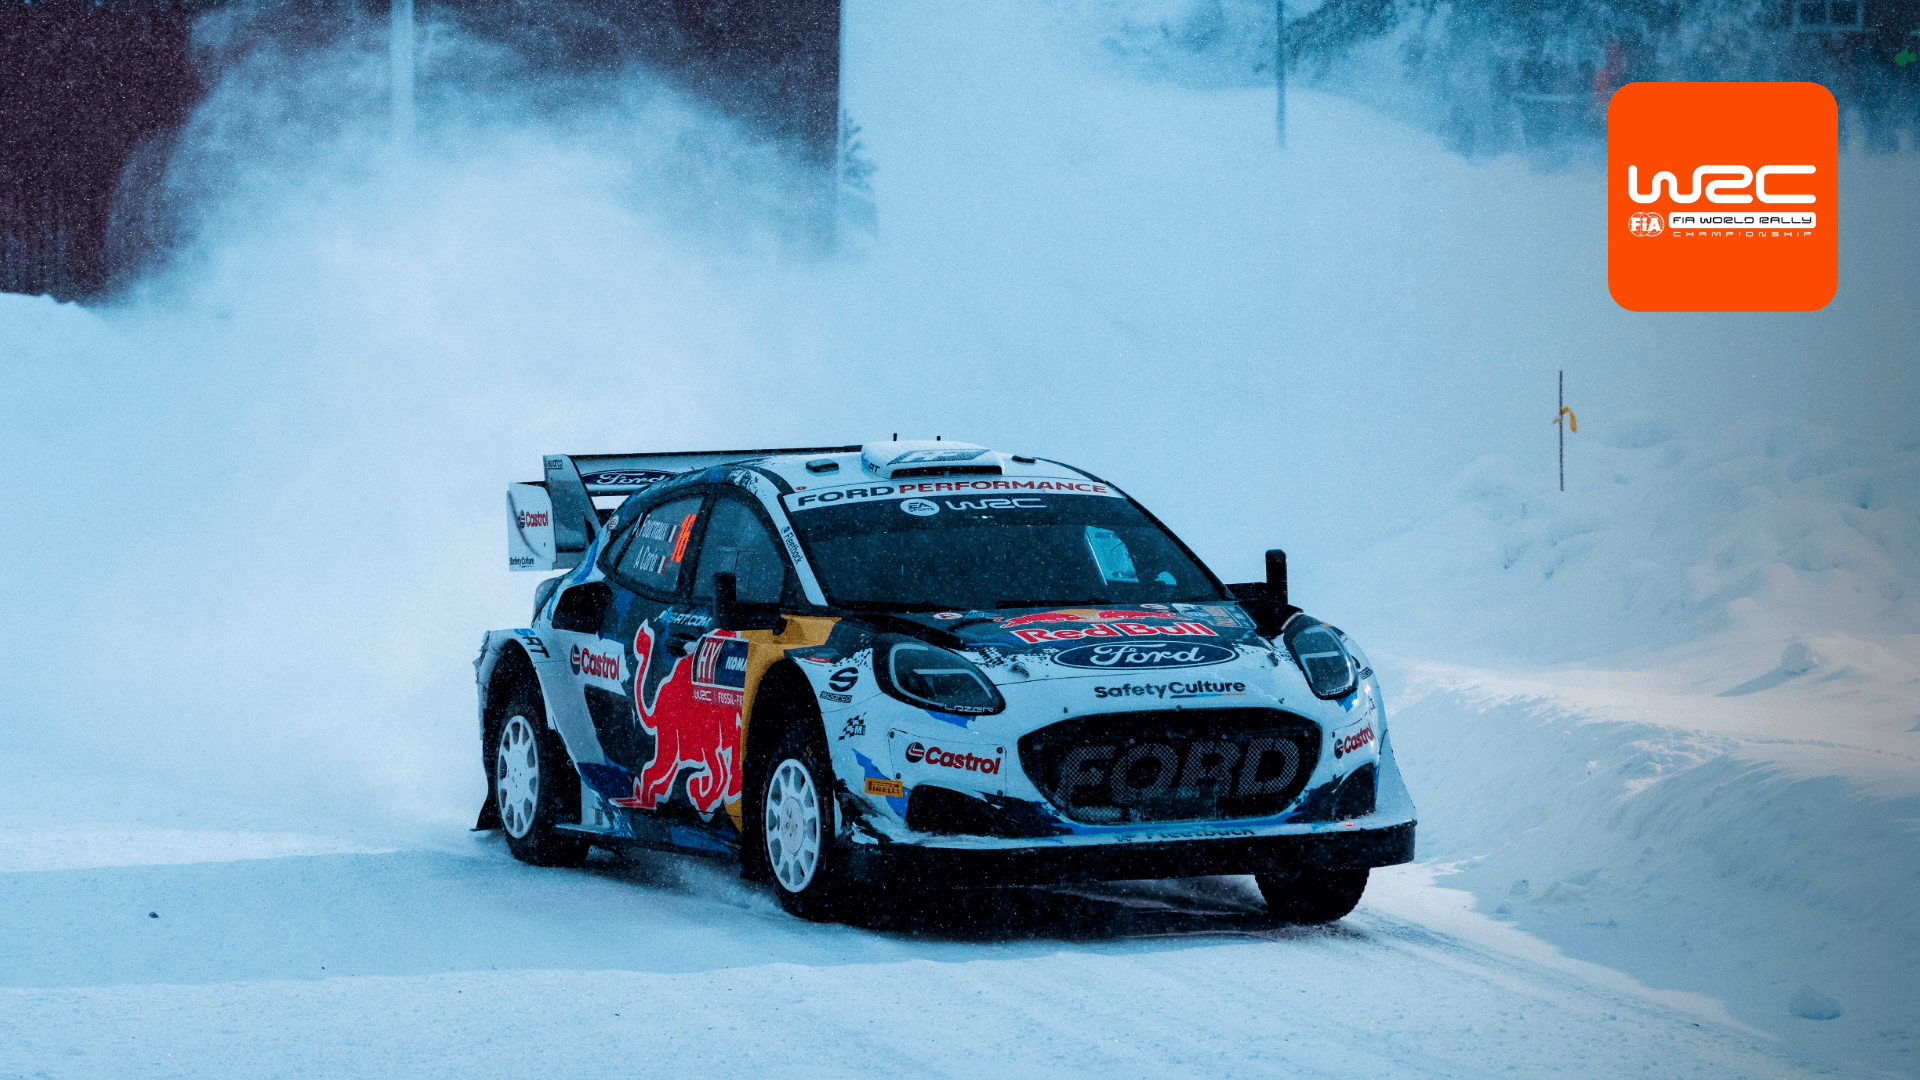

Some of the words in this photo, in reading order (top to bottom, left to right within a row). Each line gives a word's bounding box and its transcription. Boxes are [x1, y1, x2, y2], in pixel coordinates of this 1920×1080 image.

[596, 472, 667, 485] Ford
[798, 486, 895, 506] FORD
[899, 480, 1108, 494] PERFORMANCE
[945, 498, 1047, 510] WRC
[525, 511, 549, 528] Castrol
[784, 531, 804, 566] Fleetback
[1010, 623, 1123, 644] Red
[1110, 622, 1220, 637] Bull
[581, 647, 620, 681] Castrol
[1090, 642, 1206, 666] Ford
[821, 692, 851, 702] sparco
[1094, 680, 1246, 699] SafetyCulture
[945, 704, 994, 713] LAZER
[1344, 723, 1375, 754] Castrol
[925, 747, 1001, 775] Castrol
[1054, 738, 1300, 802] FORD
